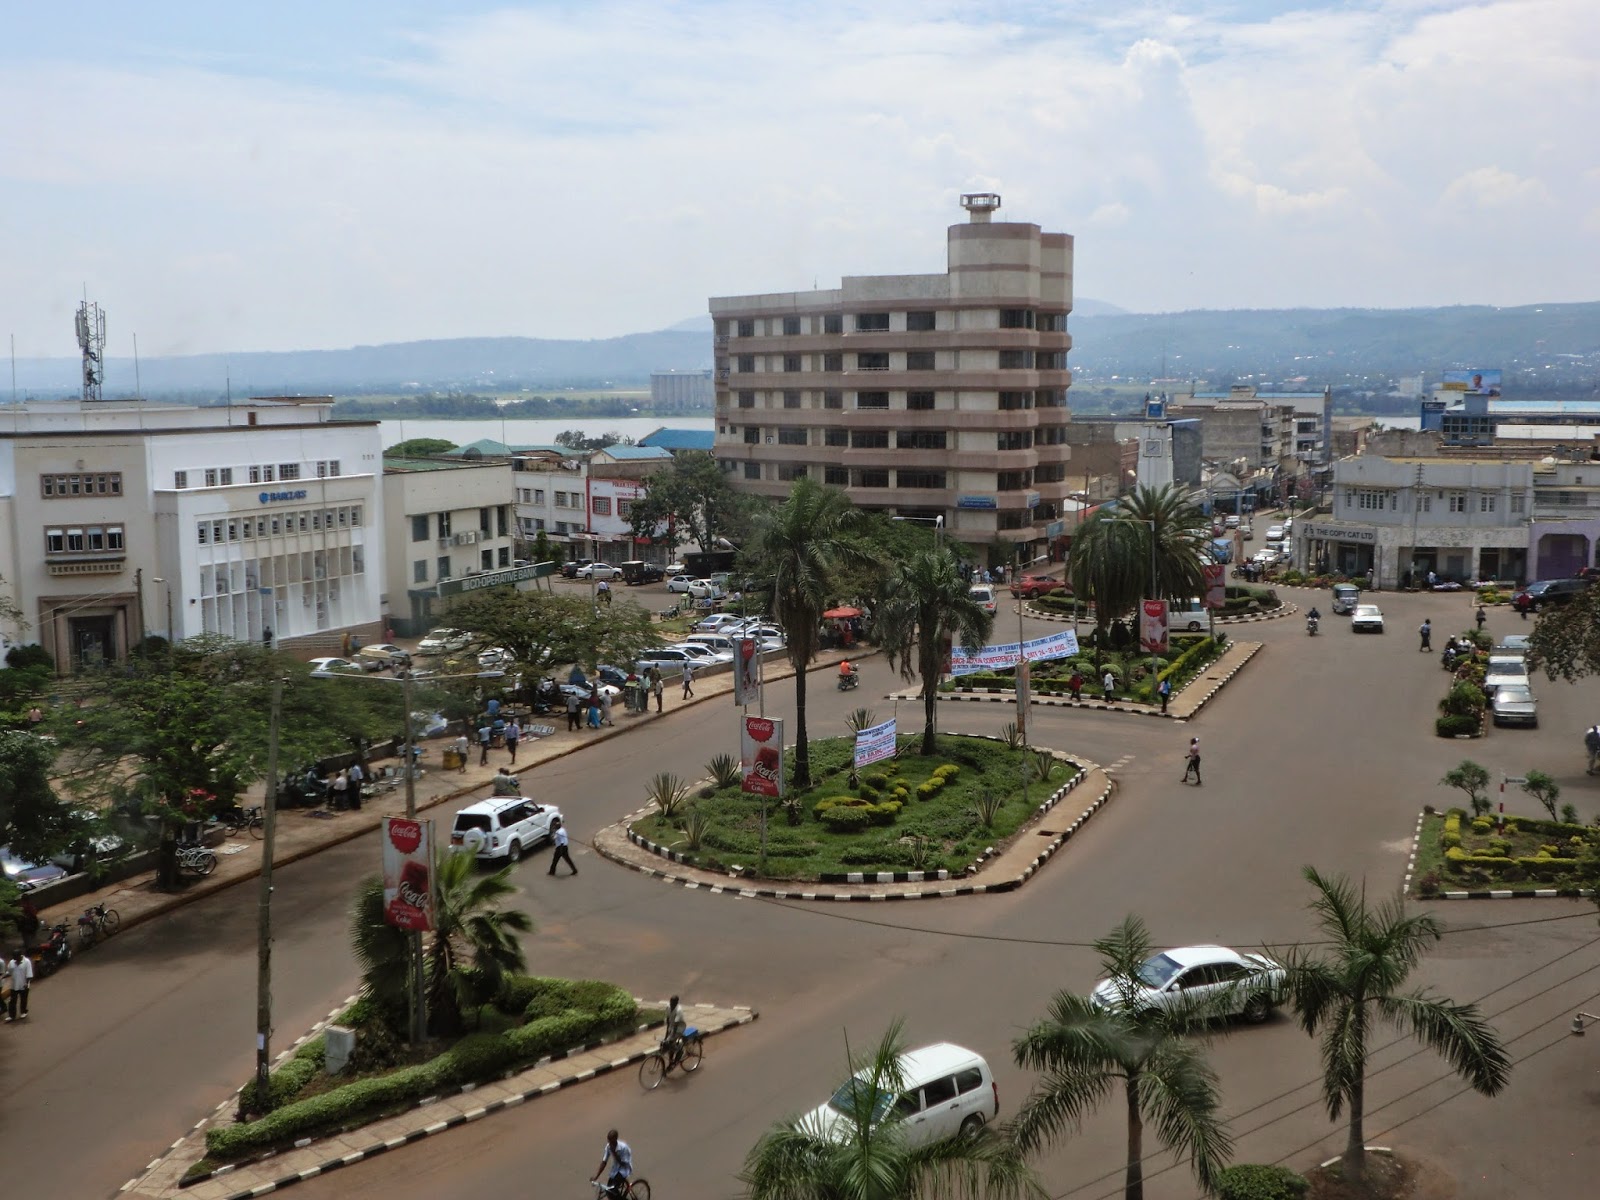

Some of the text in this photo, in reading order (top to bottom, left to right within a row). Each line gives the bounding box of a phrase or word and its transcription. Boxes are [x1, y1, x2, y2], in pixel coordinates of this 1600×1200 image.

[1316, 528, 1374, 540] THE COPY CAT LTD
[470, 567, 537, 589] CO-OPERATIVE BANK
[749, 721, 771, 732] Coca-Cola
[391, 824, 417, 838] Coca-Cola
